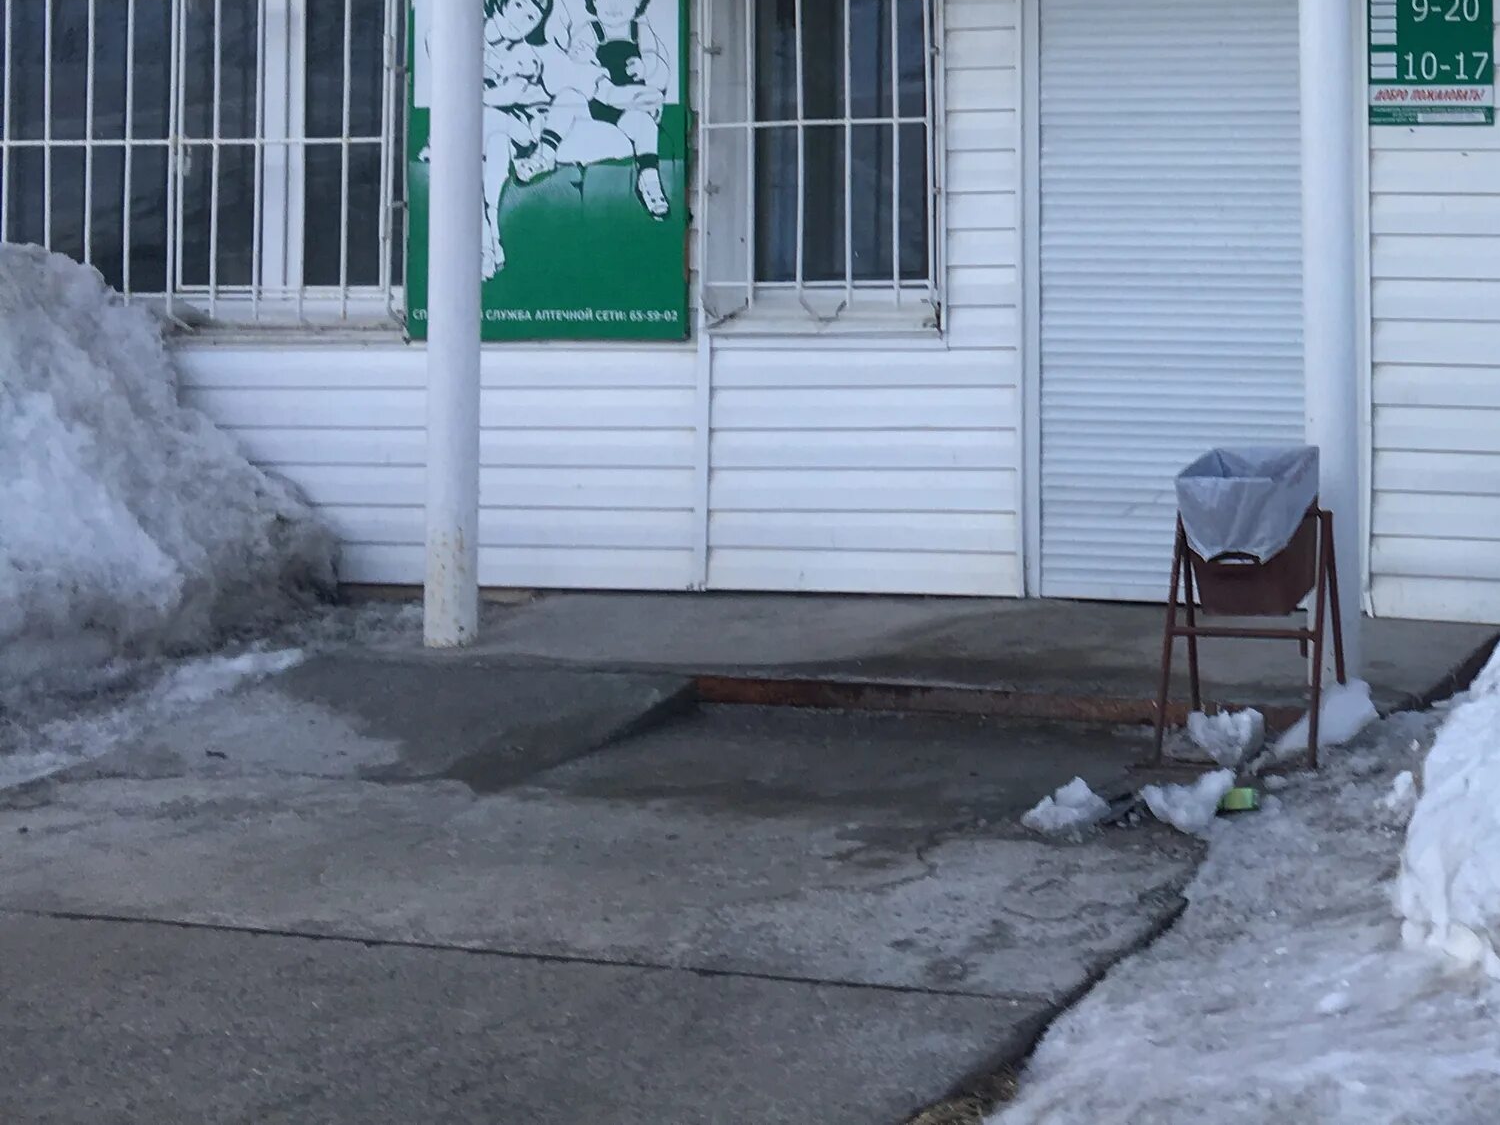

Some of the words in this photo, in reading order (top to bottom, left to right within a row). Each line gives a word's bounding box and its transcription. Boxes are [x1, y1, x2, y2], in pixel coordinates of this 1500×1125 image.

[1403, 51, 1490, 80] 10-17
[485, 308, 533, 322] СЛУЖБА
[535, 307, 593, 322] АПТЕЧНОЙ
